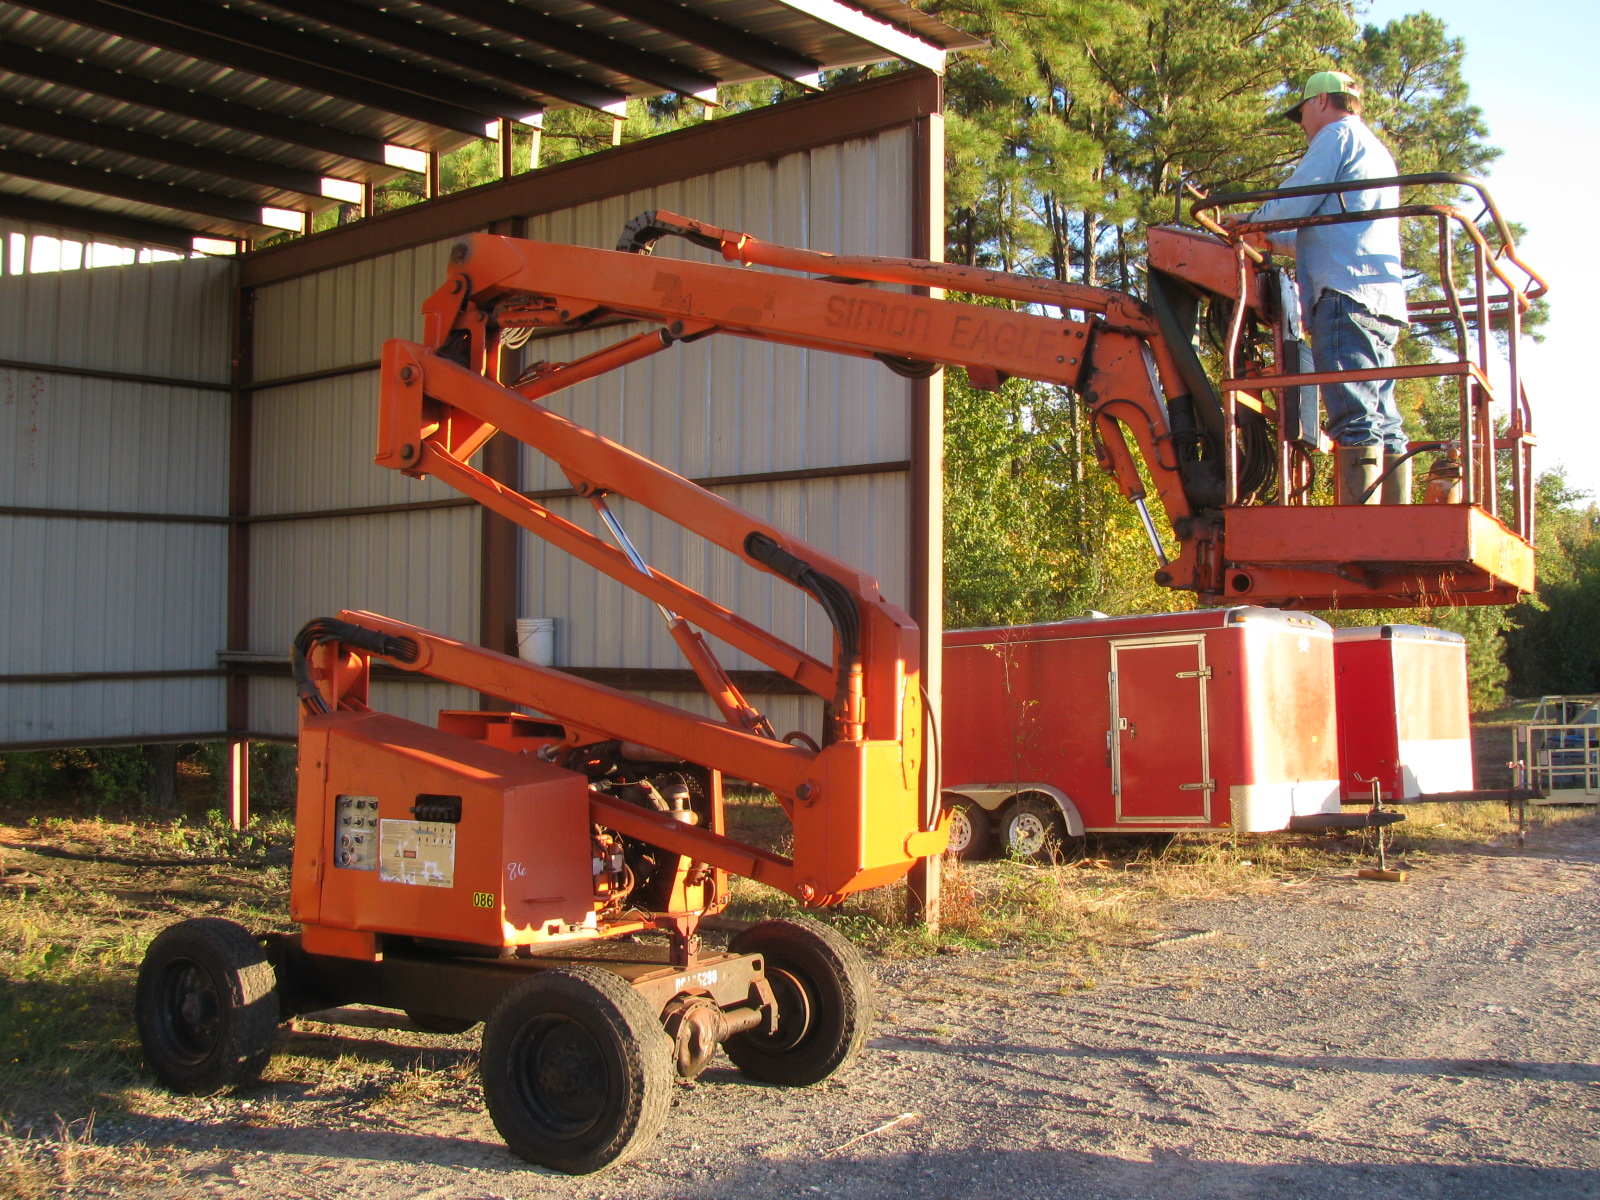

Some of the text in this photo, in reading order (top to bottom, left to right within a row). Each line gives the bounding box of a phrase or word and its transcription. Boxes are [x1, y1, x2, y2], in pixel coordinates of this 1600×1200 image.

[950, 315, 1057, 362] EAGLE
[507, 862, 526, 880] 86
[474, 892, 493, 908] 086
